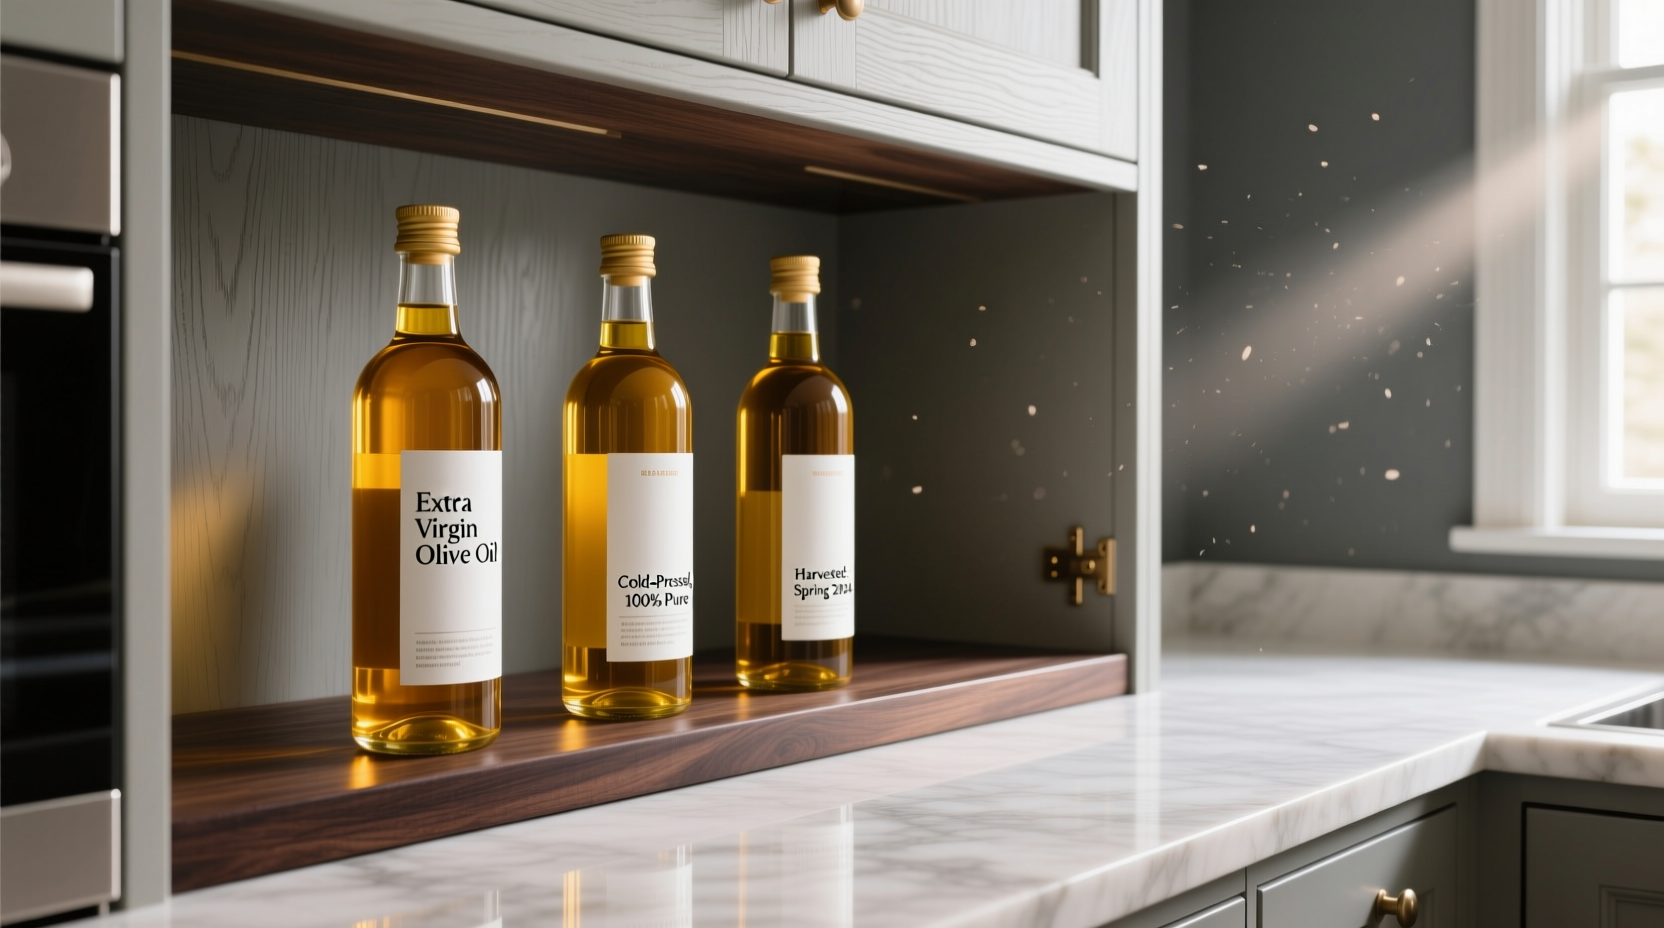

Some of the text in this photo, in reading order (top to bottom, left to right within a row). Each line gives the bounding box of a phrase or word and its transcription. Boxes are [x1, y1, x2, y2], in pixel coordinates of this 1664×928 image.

[415, 491, 472, 513] Extra
[414, 517, 478, 544] Virgin
[415, 541, 498, 565] Olive Oil
[624, 592, 689, 608] 100% Pure
[793, 583, 830, 601] Spring
